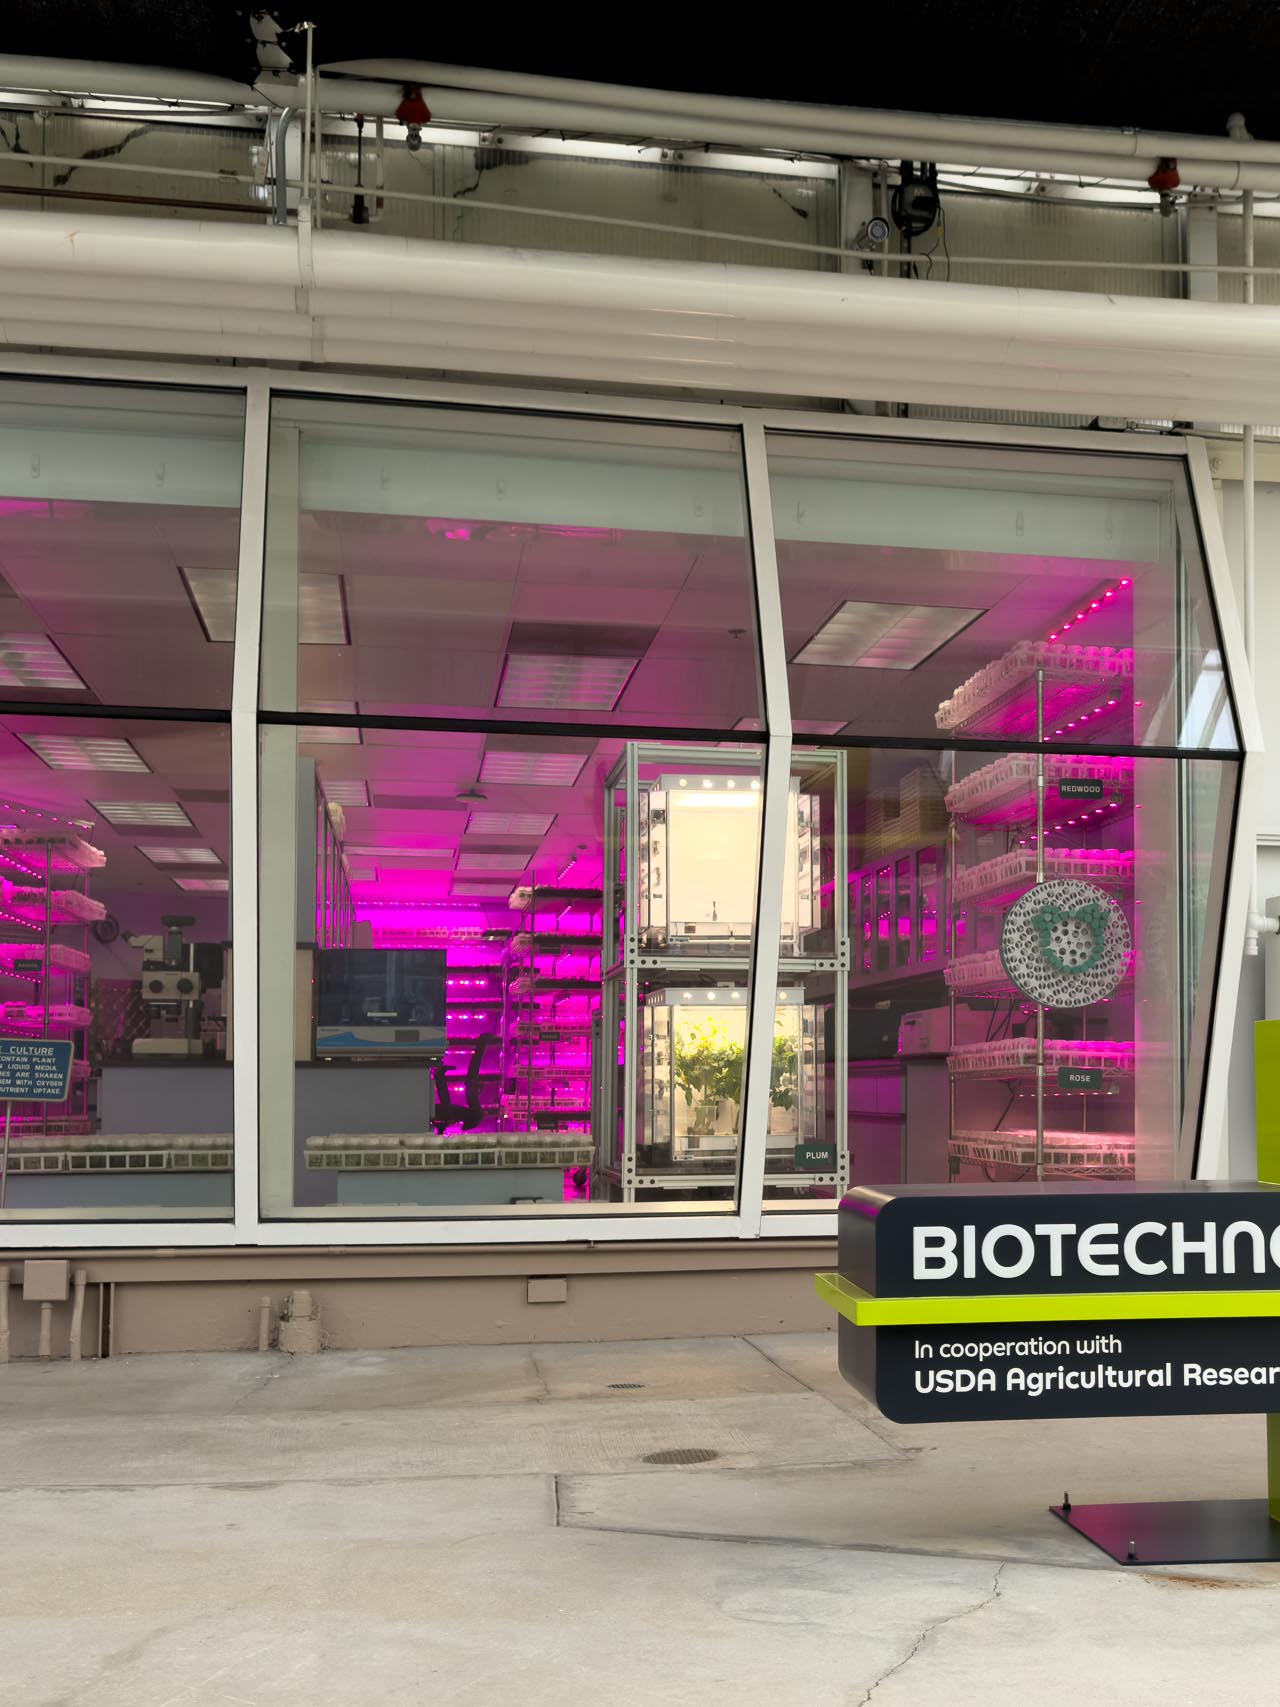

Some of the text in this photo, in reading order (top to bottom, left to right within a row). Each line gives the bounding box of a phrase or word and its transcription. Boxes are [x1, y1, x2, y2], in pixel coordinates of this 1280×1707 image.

[1061, 785, 1101, 793] REDWOOD
[9, 1046, 54, 1056] CULTURE
[1069, 1074, 1092, 1082] ROSE
[805, 1151, 829, 1160] PLUM
[914, 1334, 1122, 1362] In cooperation with
[914, 1369, 997, 1394] USDA
[1006, 1362, 1173, 1397] Agricultural
